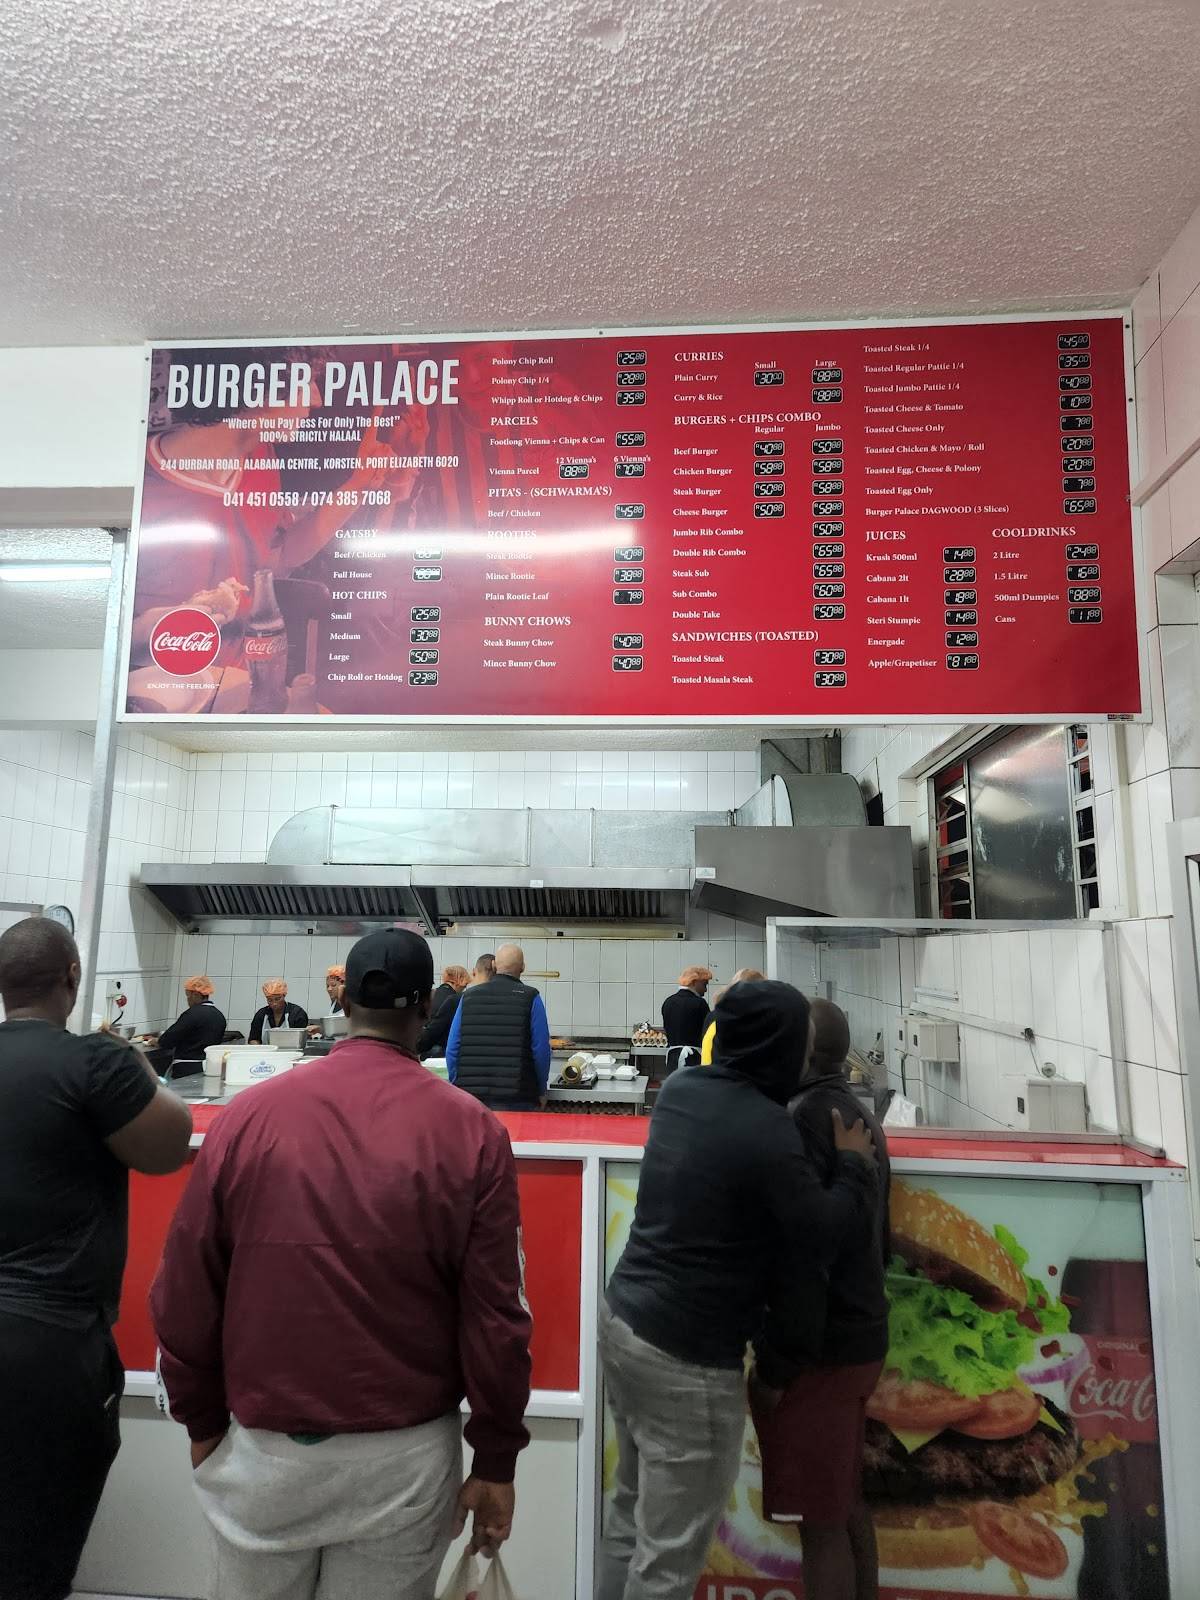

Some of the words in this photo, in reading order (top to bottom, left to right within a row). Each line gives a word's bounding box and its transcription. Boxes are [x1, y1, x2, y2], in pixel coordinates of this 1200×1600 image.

[675, 352, 723, 361] CURRIES
[492, 358, 517, 366] Polony
[519, 358, 536, 366] Chip
[755, 361, 776, 369] Small
[815, 360, 836, 368] Large
[696, 374, 717, 382] Curry
[167, 362, 311, 409] BURGER
[324, 360, 459, 406] PALACE
[492, 397, 516, 405] Whipp
[934, 403, 963, 411] Tomato
[259, 417, 275, 428] You
[277, 417, 293, 428] Pay
[296, 417, 316, 428] Less
[318, 417, 332, 427] For
[335, 417, 354, 428] Only
[356, 416, 371, 426] The
[491, 417, 538, 425] PARCELS
[674, 416, 726, 425] BURGERS
[738, 414, 773, 423] CHIPS
[776, 412, 821, 422] COMBO
[755, 426, 784, 434] Regular
[815, 424, 841, 432] Jumbo
[260, 432, 288, 442] 100%
[290, 431, 328, 442] STRICTLY
[330, 431, 361, 441] HALAAL
[490, 438, 522, 446] Footlong
[559, 437, 580, 445] Chips
[692, 448, 718, 456] Burger
[865, 446, 894, 454] Toasted
[896, 445, 928, 453] Chicken
[940, 445, 961, 453] Mayo
[160, 459, 177, 469] 244
[178, 459, 214, 470] DURBAN
[216, 459, 242, 471] ROAD,
[244, 458, 285, 469] ALABAMA
[288, 458, 321, 470] CENTRE,
[324, 458, 364, 469] KORSTEN,
[366, 457, 387, 468] PORT
[390, 456, 433, 468] ELIZABETH
[436, 456, 458, 467] 6020
[707, 468, 732, 476] Burger
[696, 488, 721, 496] Burger
[223, 493, 244, 506] 041
[247, 492, 267, 506] 451
[269, 491, 299, 506] 0558
[311, 491, 334, 505] 074
[337, 491, 358, 504] 385
[361, 490, 391, 504] 7068
[702, 509, 728, 517] Burger
[865, 508, 892, 517] Burger
[894, 507, 919, 515] Palace
[672, 529, 698, 537] Jumbo
[700, 528, 713, 536] Rib
[866, 531, 905, 542] JUICES
[992, 527, 1076, 538] COOLDRINKS
[866, 553, 890, 561] Krush
[893, 553, 917, 561] 500ml
[993, 551, 998, 559] 2
[1000, 551, 1019, 559] Litre
[672, 569, 692, 577] Steak
[695, 569, 709, 577] Sub
[1009, 572, 1028, 580] Litre
[332, 591, 354, 599] HOT
[356, 591, 387, 599] CHIPS
[689, 590, 717, 598] Combo
[331, 612, 351, 620] Small
[995, 615, 1015, 623] Cans
[484, 617, 525, 626] BUNNY
[528, 617, 571, 626] CHOWS
[672, 632, 752, 642] SANDWICHES
[154, 632, 216, 651] Coca-Cola
[506, 639, 530, 648] Bunny
[867, 638, 905, 647] Energade
[329, 653, 350, 662] Large
[328, 674, 346, 682] Chip
[348, 673, 363, 681] Roll
[375, 673, 402, 682] Hotdog
[732, 675, 753, 683] Steak
